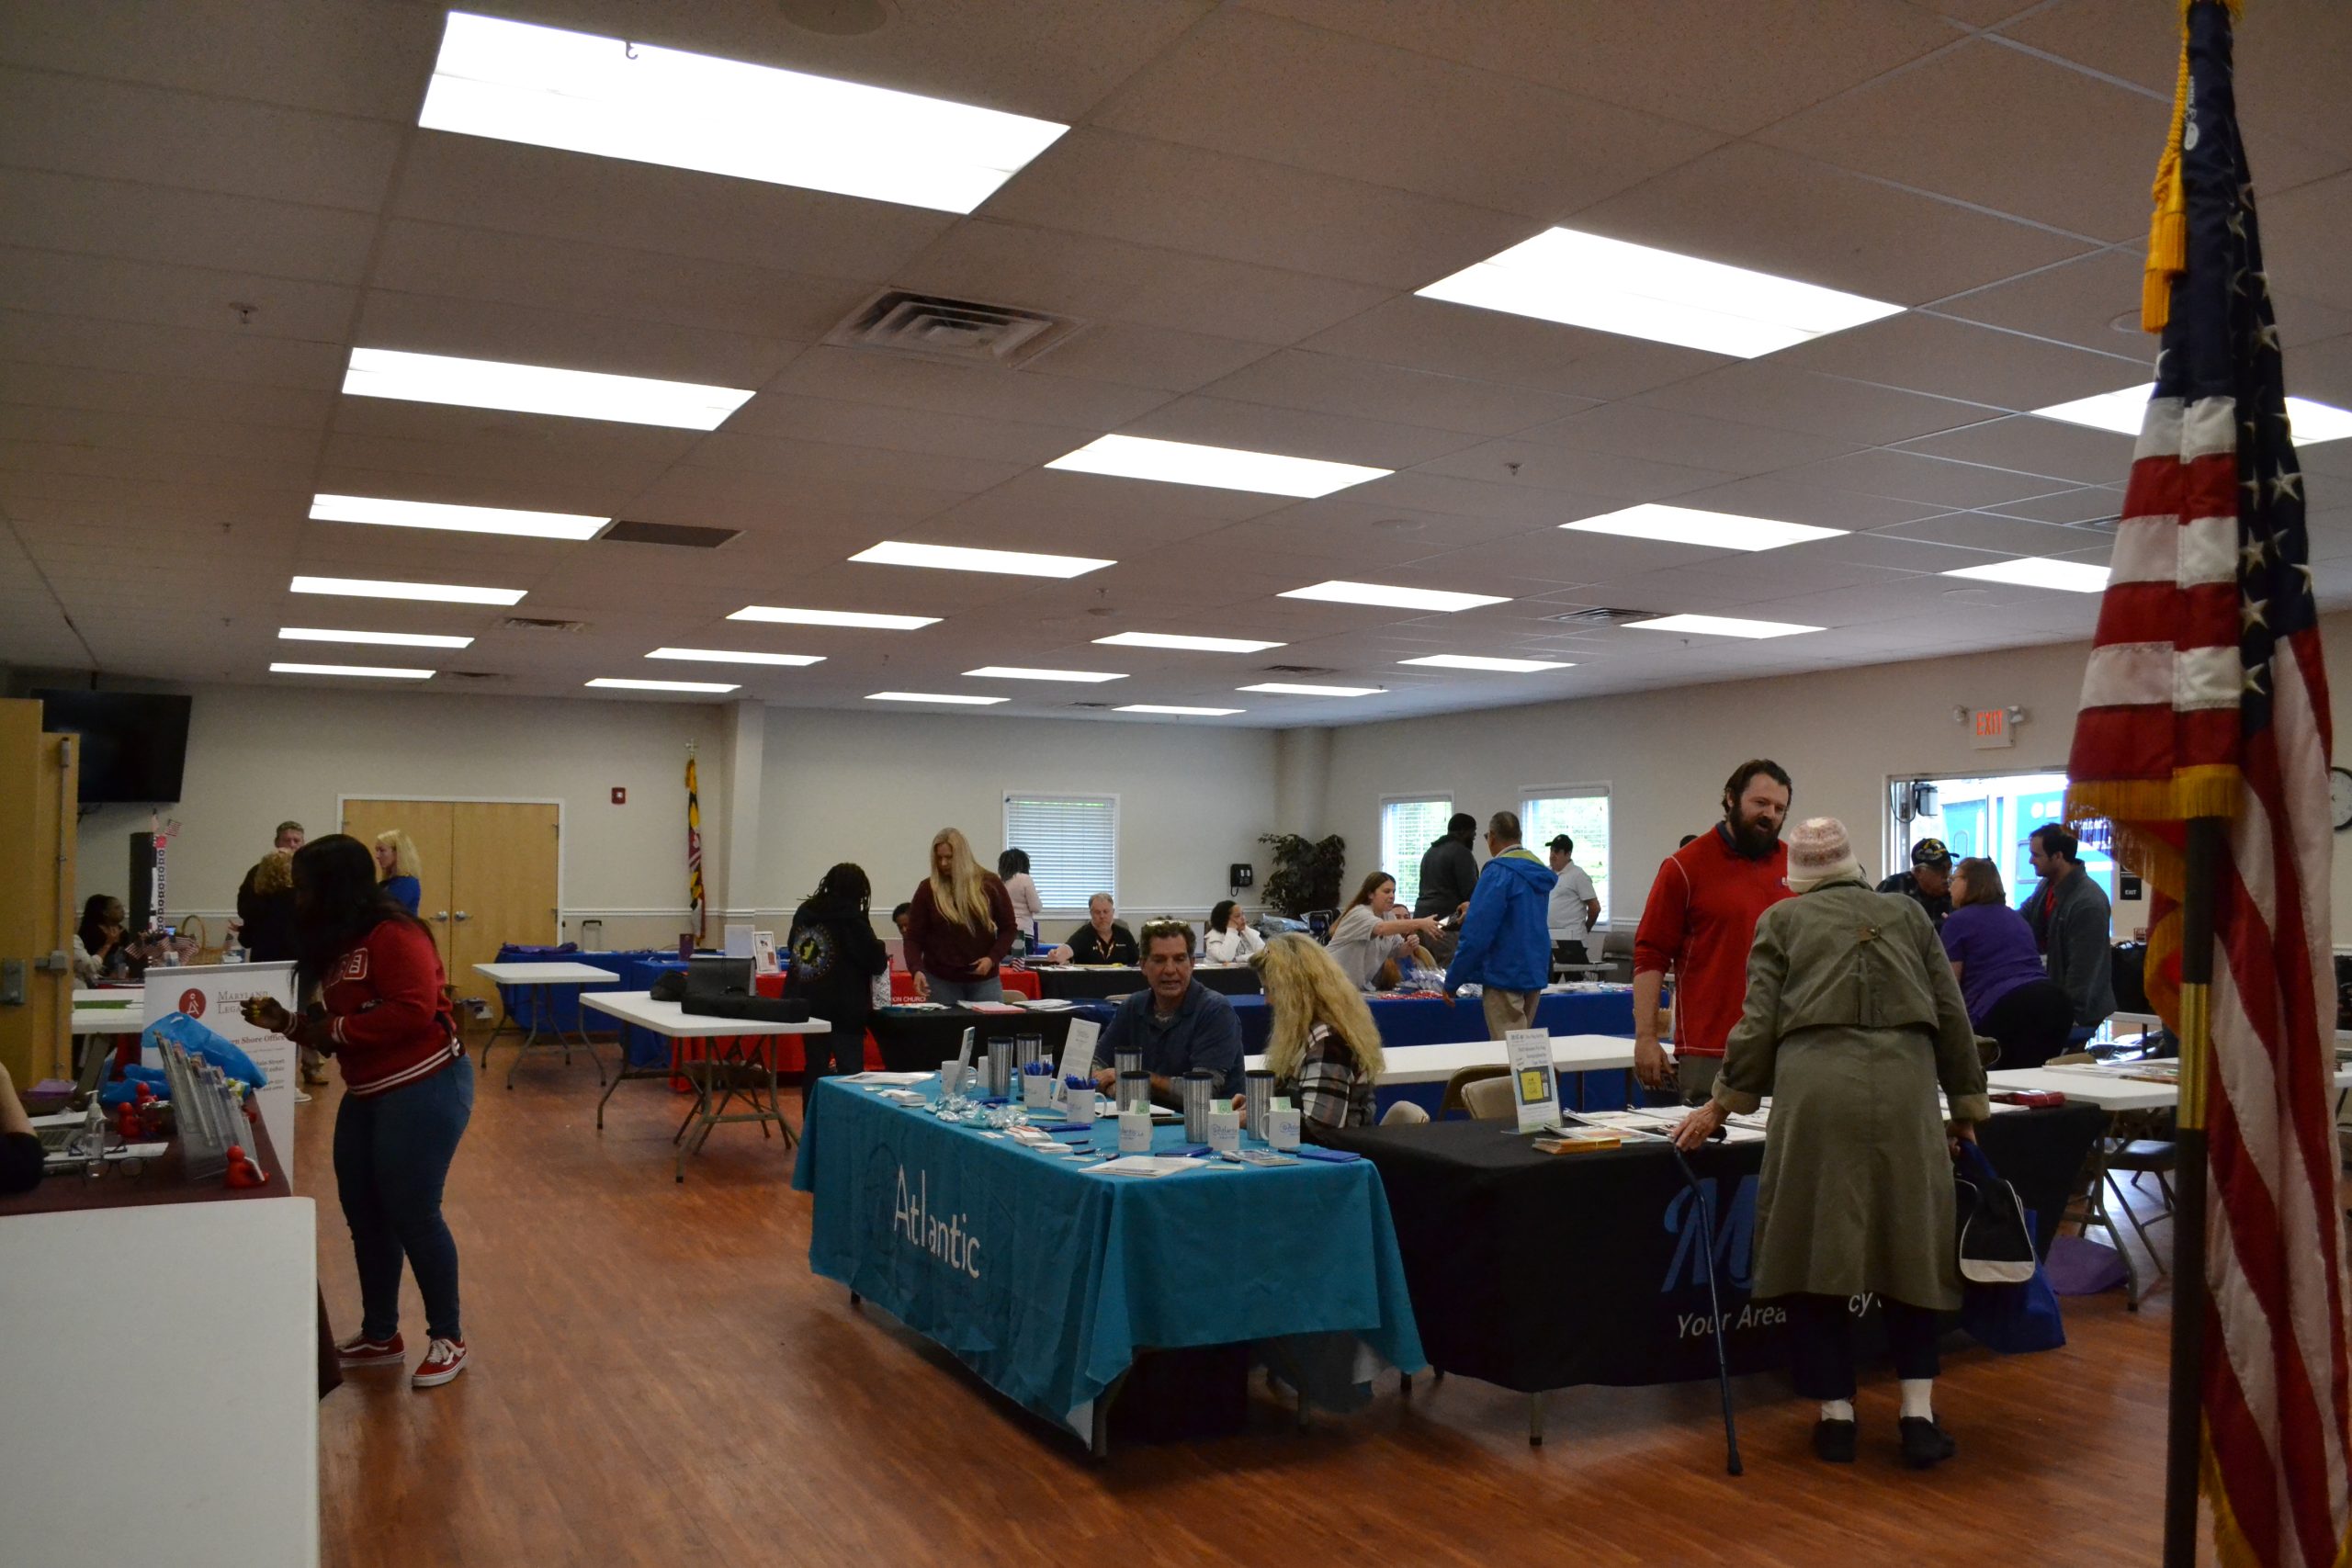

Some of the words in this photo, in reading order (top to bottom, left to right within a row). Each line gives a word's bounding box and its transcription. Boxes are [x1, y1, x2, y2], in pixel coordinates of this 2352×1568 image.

[1976, 709, 2002, 735] EXIT
[218, 1004, 241, 1014] LEGA
[894, 1163, 981, 1279] Atlantic
[1736, 1303, 1788, 1331] Area
